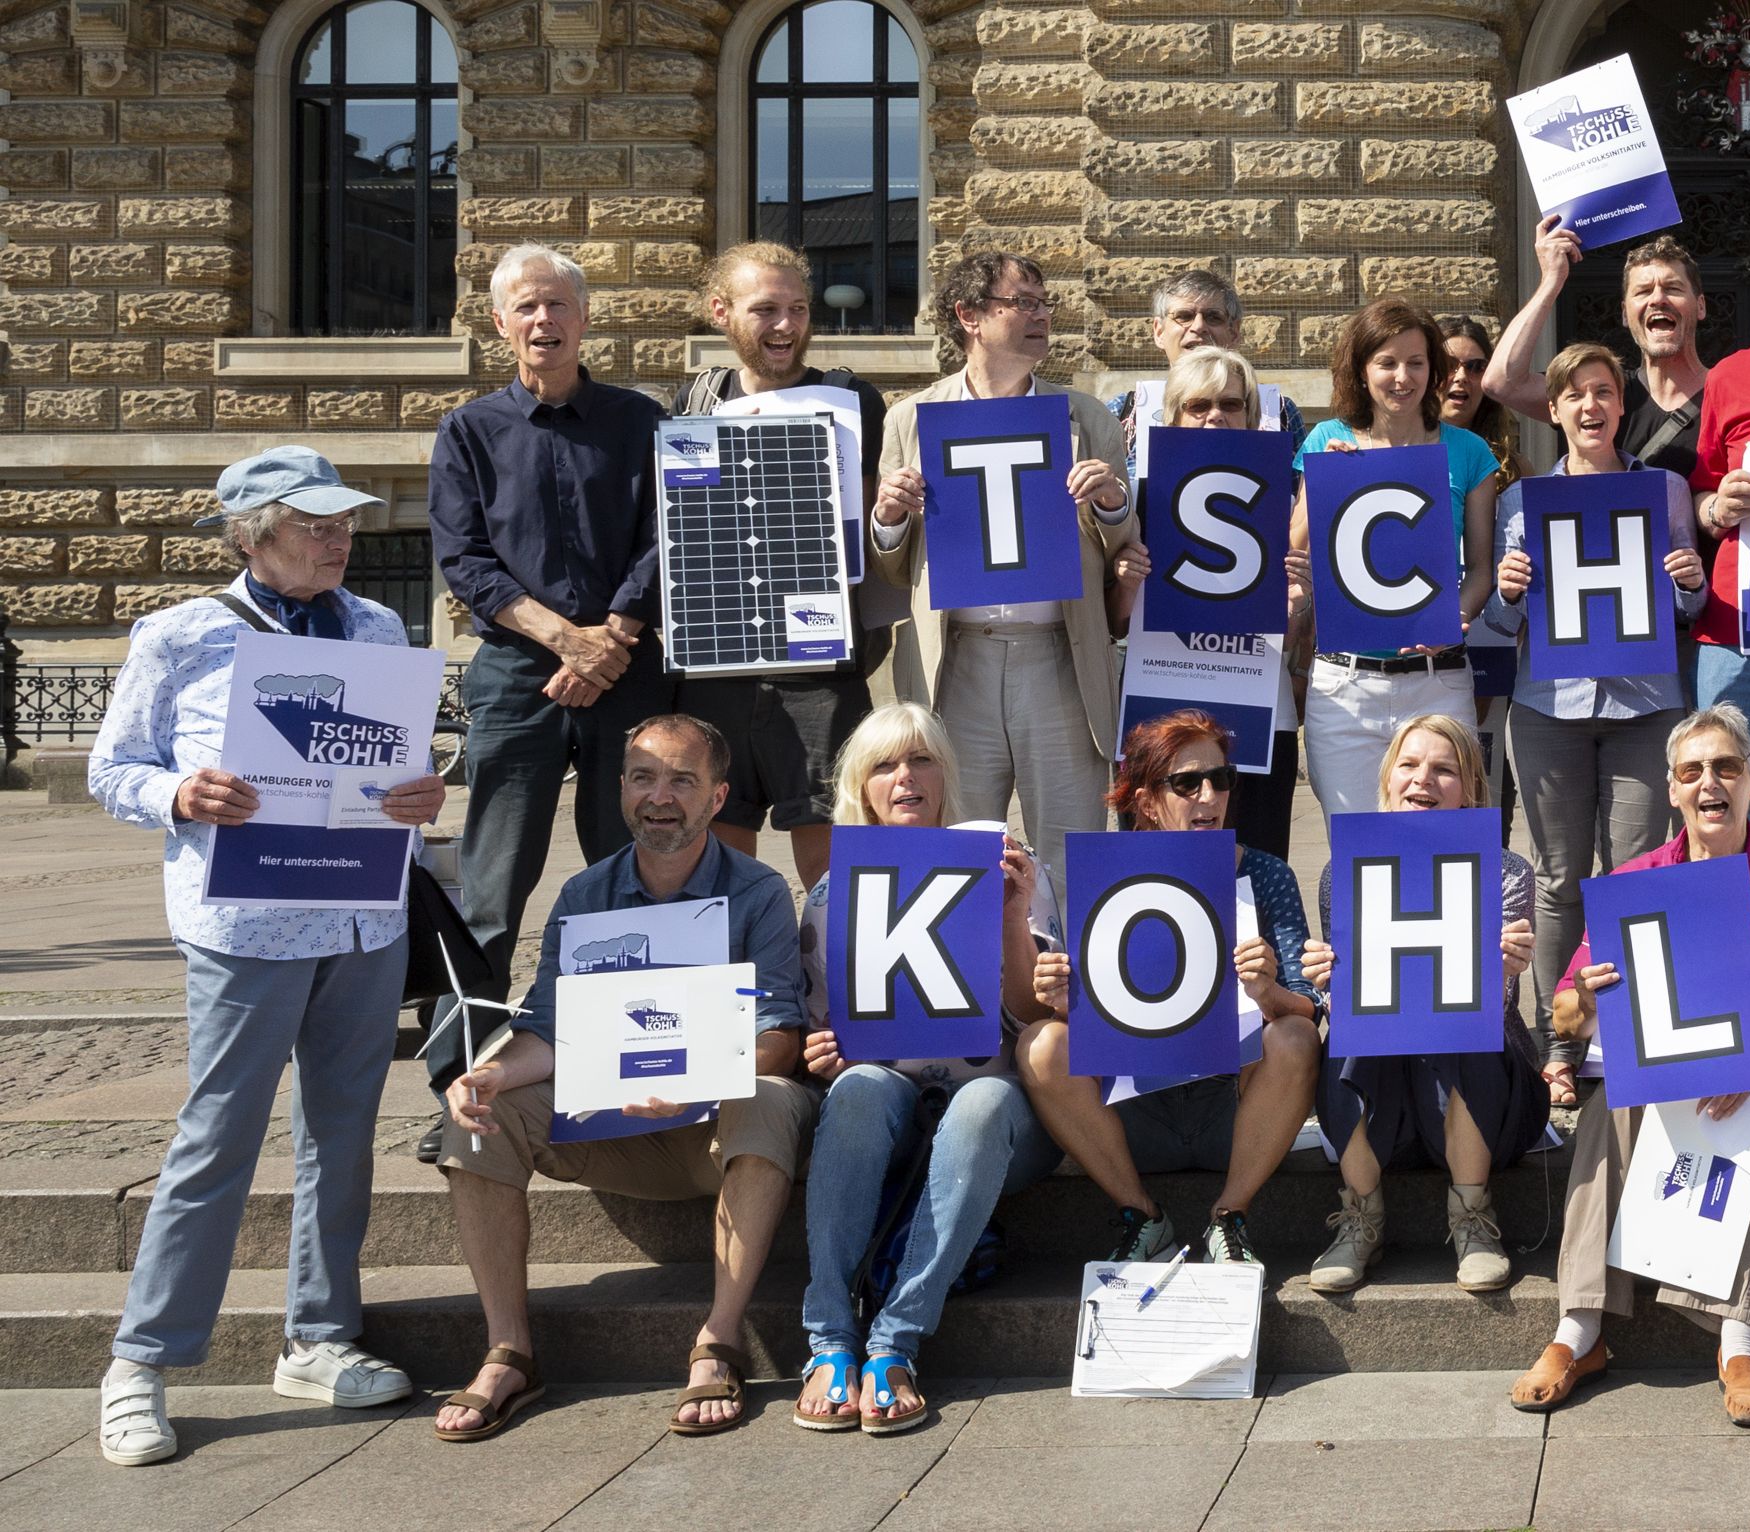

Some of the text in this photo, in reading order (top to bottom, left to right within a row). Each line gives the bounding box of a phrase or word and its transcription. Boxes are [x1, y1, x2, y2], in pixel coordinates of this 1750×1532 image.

[1567, 104, 1634, 137] TSCHÜSS
[1571, 115, 1642, 152] KOHLE
[1542, 161, 1586, 183] HAMBURGER
[1587, 140, 1647, 165] VOLKSINITIATIVE
[1575, 202, 1647, 228] Hier unterschreiben.
[1189, 632, 1267, 657] KOHLE
[1142, 658, 1263, 676] HAMBURGER VOLKSINITIATIVE
[1142, 669, 1216, 681] www.tschuess-kohle.de
[310, 721, 409, 745] TSCHÜSS
[307, 739, 410, 767] KOHLE
[242, 774, 313, 788] HAMBURGER
[257, 788, 330, 801] w.tschuess-kohle
[259, 855, 363, 868] Hier unterschreiben.
